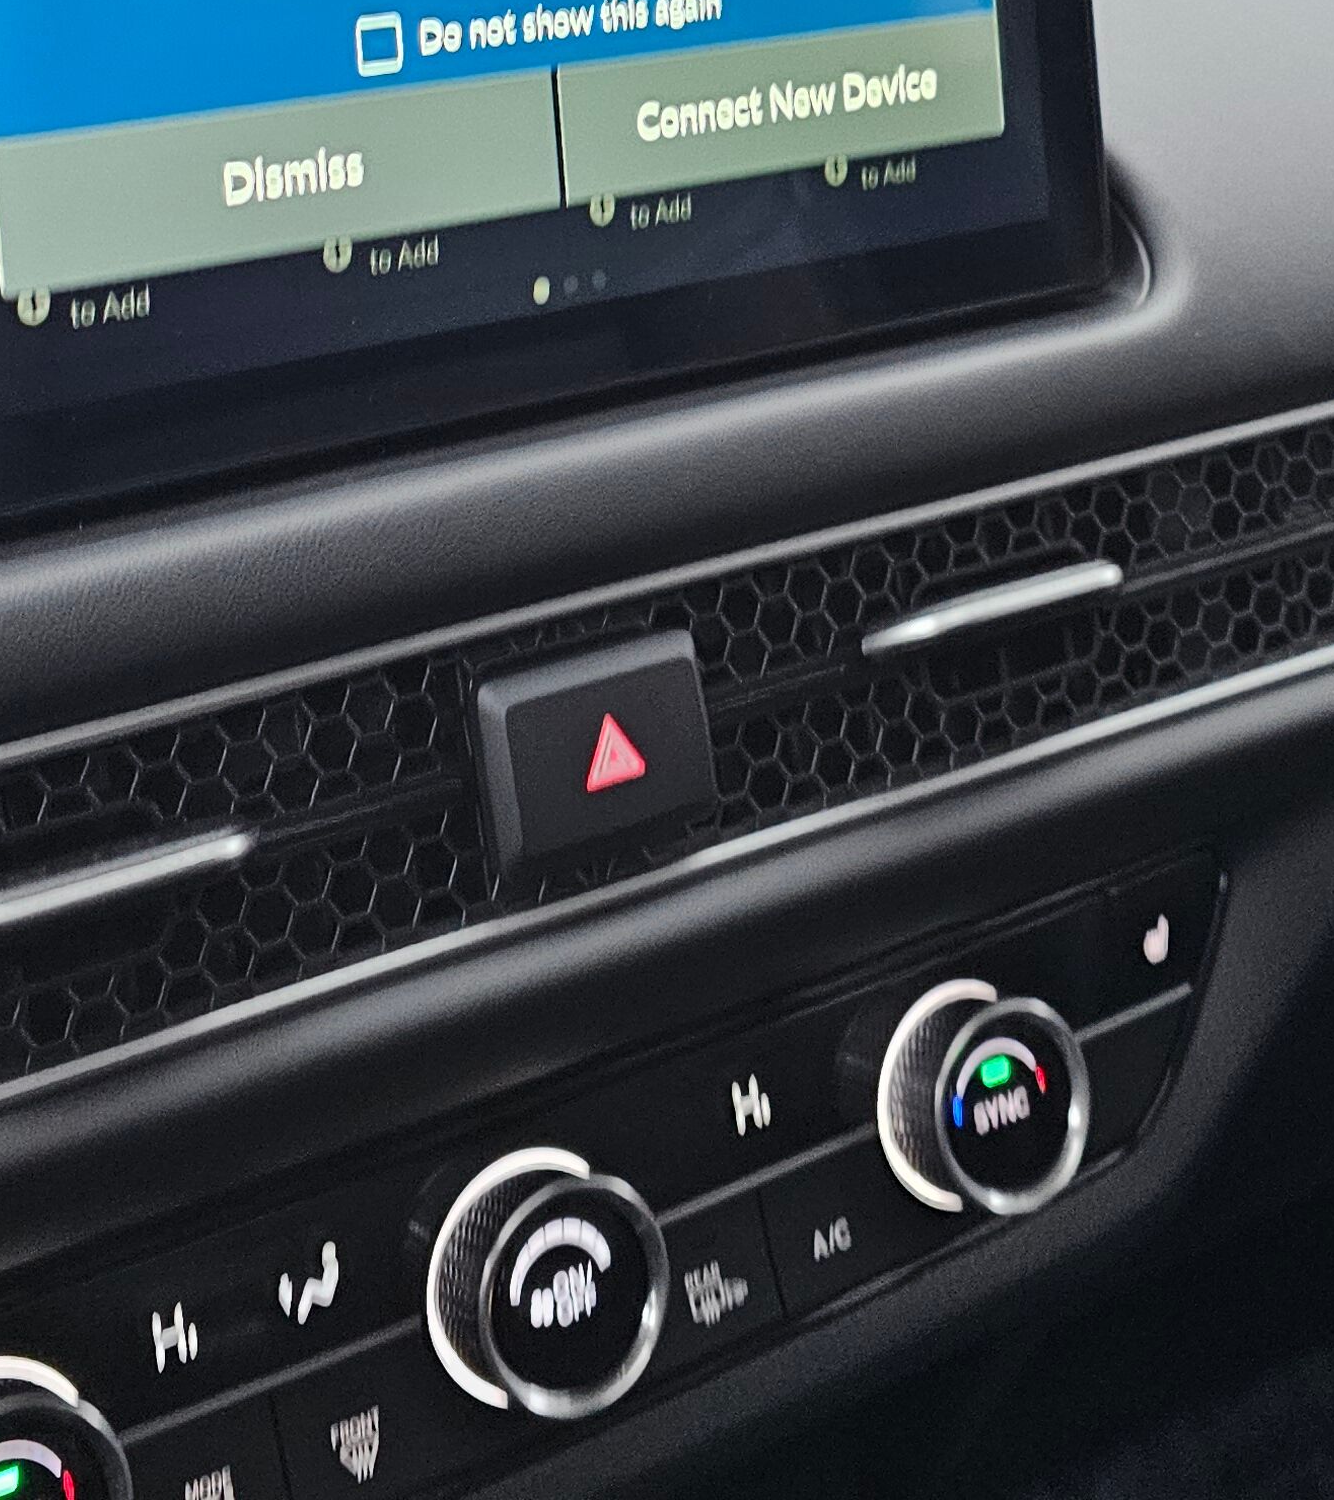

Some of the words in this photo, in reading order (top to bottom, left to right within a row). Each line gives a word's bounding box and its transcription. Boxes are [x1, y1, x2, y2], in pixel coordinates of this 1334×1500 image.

[420, 17, 463, 57] Do
[470, 8, 516, 49] not
[523, 2, 594, 43] show
[637, 87, 764, 142] Connect
[769, 80, 836, 124] New
[842, 63, 938, 113] Device
[223, 146, 364, 207] Dismiss
[861, 166, 879, 191] to
[884, 155, 916, 187] Add
[630, 202, 650, 231] to
[655, 192, 692, 227] Add
[370, 247, 392, 276] to
[398, 233, 439, 272] Add
[71, 298, 95, 330] to
[102, 282, 150, 325] Add
[974, 1085, 1030, 1136] SYNC
[814, 1216, 852, 1262] A/C
